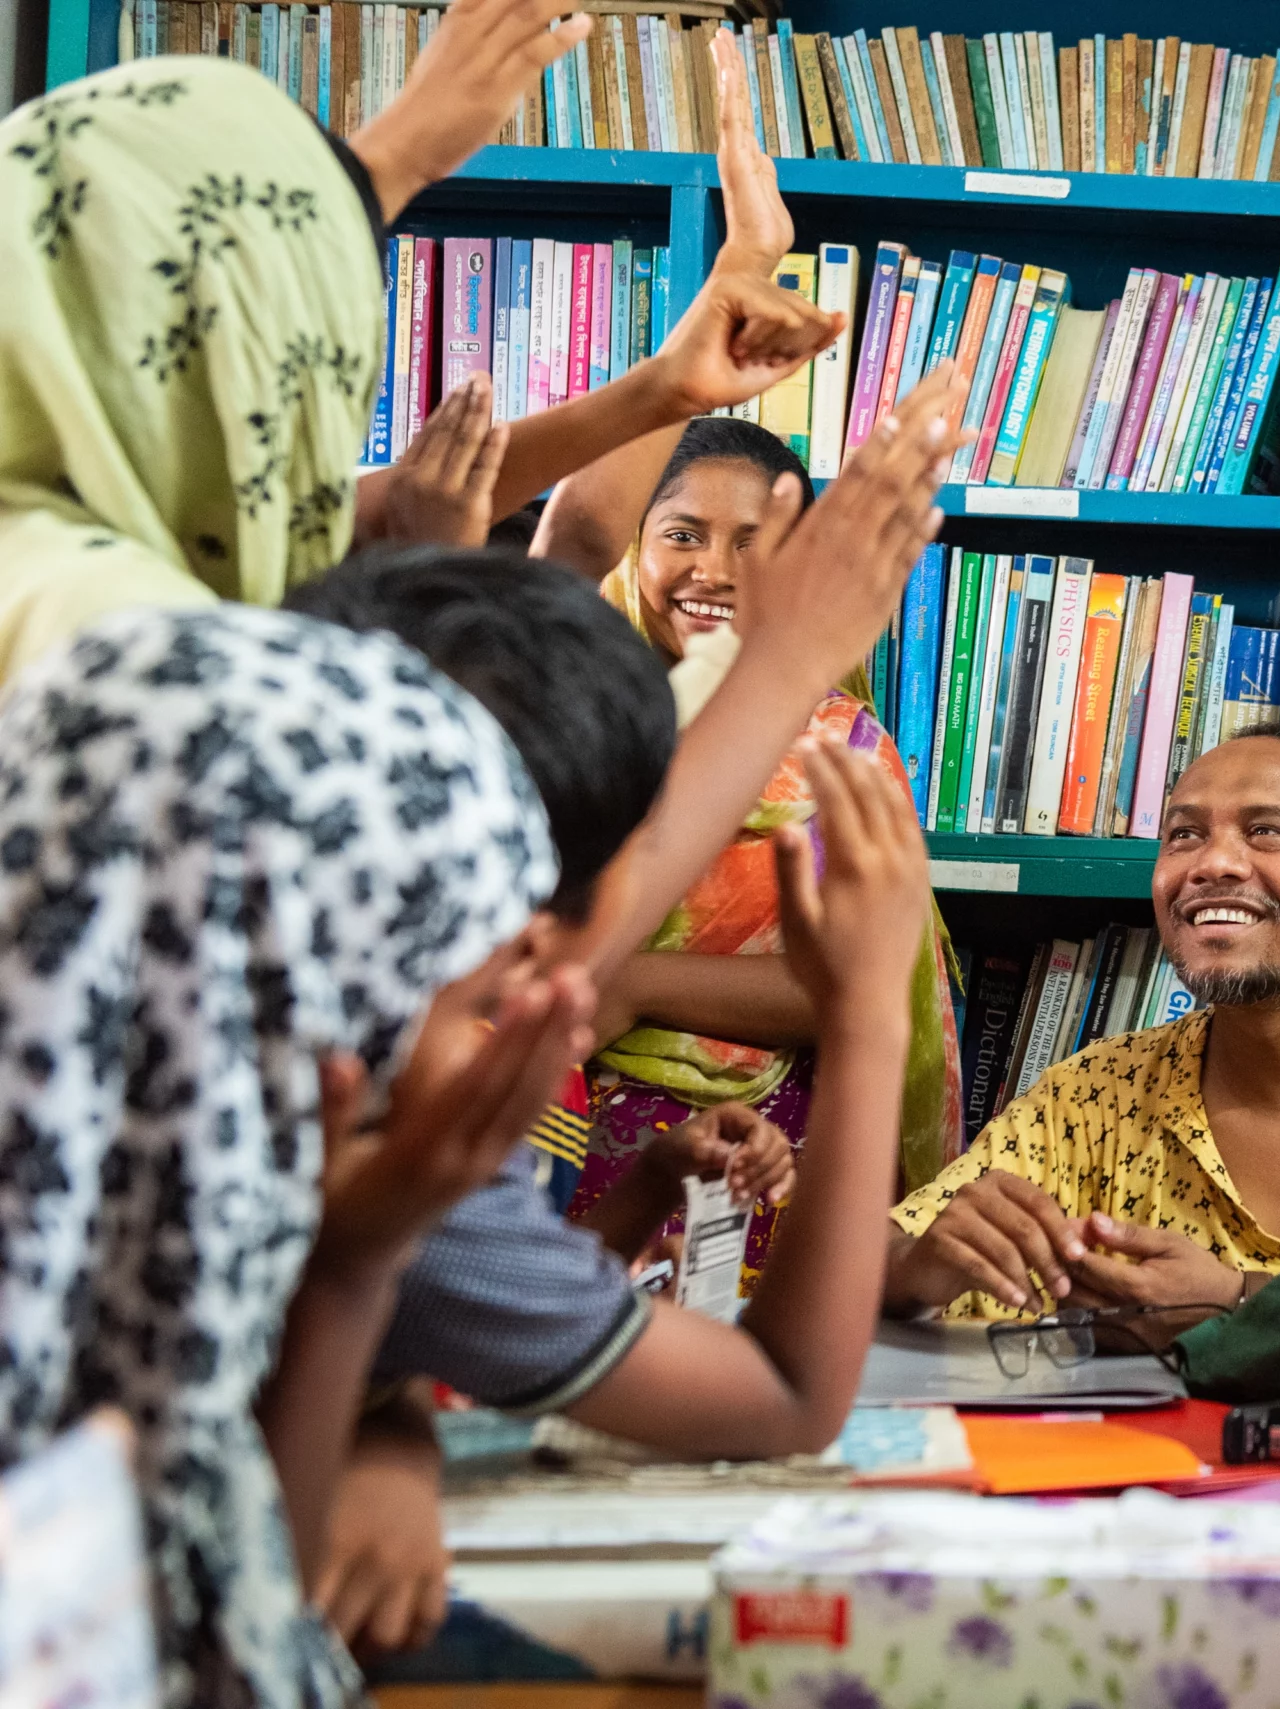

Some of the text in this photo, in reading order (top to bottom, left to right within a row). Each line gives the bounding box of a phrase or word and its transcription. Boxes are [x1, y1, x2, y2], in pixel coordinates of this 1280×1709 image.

[399, 250, 411, 299] উচ্চতর গণিত
[413, 259, 427, 321] পদার্থবিজ্ঞান
[576, 286, 588, 323] ব্যবস্থাপনা
[637, 281, 649, 326] অর্থনীতি
[876, 283, 890, 308] Clinical
[466, 275, 482, 336] হিসাববিজ্ঞান
[497, 308, 507, 338] রসায়ন
[868, 310, 885, 361] Pharmacology
[1008, 310, 1026, 360] Grammar Scan
[934, 337, 943, 350] AND
[866, 363, 877, 371] for
[1004, 320, 1048, 438] NEUROPSYCHOLOGY
[863, 373, 876, 393] Nurses
[1239, 405, 1257, 441] VOLUME
[966, 563, 974, 582] Record
[962, 596, 971, 617] Practice
[1056, 578, 1079, 658] PHYSICS
[915, 605, 928, 641] Reading
[960, 618, 969, 639] Journal
[1028, 605, 1039, 643] Business Studies
[877, 678, 885, 691] SEA
[1085, 627, 1109, 722] Reading Street
[1177, 615, 1209, 738] ESSENTIAL SURGICAL TECHNIQUE
[1212, 646, 1227, 705] পরিসংখ্যান
[952, 673, 964, 729] BIG IDEAS MATH
[1048, 663, 1066, 760] FIFTH EDITION TOM DUNCAN
[1249, 703, 1260, 719] the
[1172, 744, 1182, 772] CUMMING
[1179, 744, 1188, 772] JOHNSON
[1113, 936, 1122, 946] The
[1052, 960, 1072, 971] 100
[1106, 948, 1118, 974] Mounties:
[1049, 980, 1068, 1018] RANKING
[1099, 995, 1108, 1004] Saw
[1100, 983, 1111, 993] They
[1046, 1020, 1057, 1032] OF
[1092, 1005, 1105, 1032] Themselves
[1042, 1034, 1054, 1050] THE
[963, 1008, 1008, 1131] Dictionary
[1036, 1052, 1049, 1074] MOST
[1017, 1062, 1035, 1097] IN HISTO
